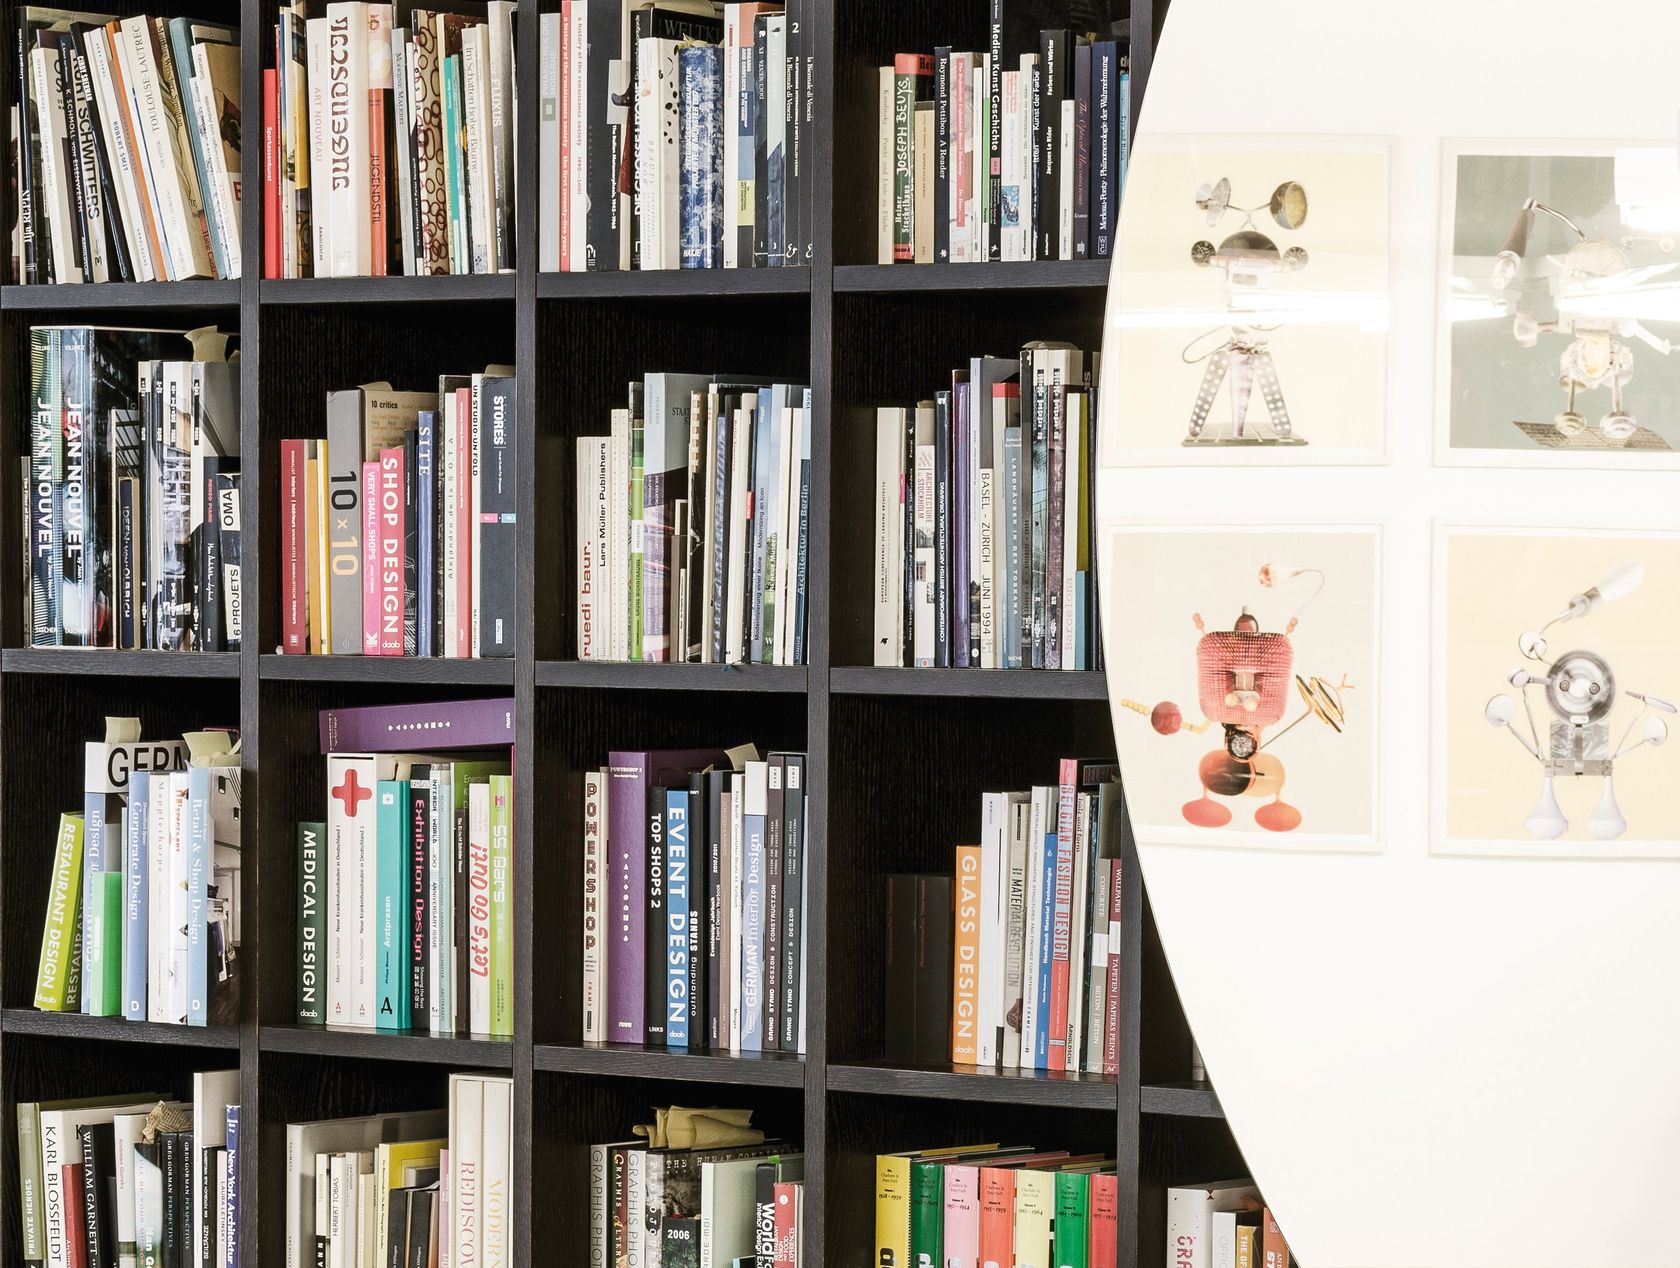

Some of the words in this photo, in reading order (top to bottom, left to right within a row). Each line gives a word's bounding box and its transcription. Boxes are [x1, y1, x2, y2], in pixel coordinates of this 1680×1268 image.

[791, 22, 800, 34] 2
[991, 23, 1000, 61] Medien
[131, 25, 160, 133] TOULOUSE-LAUTREC
[313, 87, 322, 106] ART
[938, 57, 948, 98] Raymond
[991, 63, 1000, 93] Kunst
[491, 79, 503, 128] FLUXUS
[938, 100, 948, 135] Pettibon
[991, 95, 1000, 151] Geschichte
[113, 121, 124, 149] ROBERT
[120, 151, 129, 173] SMIT
[265, 126, 273, 182] Sparkassenkunst
[314, 111, 323, 162] NOUVEAU
[895, 125, 910, 178] JOSEPH
[939, 139, 947, 147] A
[78, 107, 101, 221] SCHWITTERS
[369, 153, 381, 224] JUGENDSTIL
[939, 148, 947, 180] Reader
[37, 397, 52, 458] JEAN
[67, 397, 82, 458] JEAN
[378, 401, 398, 410] critics
[493, 395, 505, 445] STORES
[418, 425, 431, 477] SITE
[599, 442, 607, 501] Publishers
[330, 470, 358, 511] 10
[366, 470, 377, 496] VERY
[383, 457, 399, 526] SHOP
[799, 484, 808, 517] Berlin
[981, 472, 991, 510] BASEL
[37, 465, 52, 558] NOUVEL
[67, 465, 82, 558] NOUVEL
[223, 490, 235, 528] OMA
[366, 497, 377, 528] SMALL
[599, 503, 607, 539] Müller
[798, 519, 807, 530] in
[331, 535, 359, 576] 10
[366, 529, 377, 560] SHOPS
[581, 540, 592, 594] baur.
[599, 542, 607, 568] Lars
[796, 532, 807, 596] Architektur
[230, 568, 241, 625] PROJETS
[383, 538, 399, 633] DESIGN
[981, 574, 992, 600] JUNI
[233, 628, 242, 636] 6
[581, 603, 592, 657] ruedi
[982, 604, 993, 635] 1994
[128, 801, 141, 870] Corporate
[190, 799, 203, 838] Retail
[651, 812, 662, 844] TOP
[1059, 785, 1075, 841] BELGIAN
[190, 843, 202, 854] &
[413, 799, 426, 893] Exhibition
[470, 842, 489, 891] Out!
[651, 845, 662, 896] SHOPS
[669, 806, 686, 898] EVENT
[748, 833, 761, 884] Design
[52, 822, 76, 925] RESTAURANT
[128, 874, 141, 920] Design
[189, 859, 203, 894] Shop
[302, 830, 316, 918] MEDICAL
[960, 854, 977, 934] GLASS
[1056, 848, 1072, 904] FASHION
[189, 898, 202, 945] Design
[383, 895, 393, 948] Arztpraxen
[471, 894, 489, 922] Go
[651, 898, 661, 909] 2
[748, 887, 760, 941] Interior
[412, 898, 425, 961] Design
[470, 926, 489, 978] Let's
[689, 910, 699, 951] STANDS
[1054, 911, 1069, 960] DESIGN
[41, 928, 61, 988] DESIGN
[302, 926, 316, 1003] DESIGN
[669, 912, 686, 1022] DESIGN
[745, 944, 758, 1008] GERMAN
[1110, 957, 1119, 993] TAPETEN
[689, 956, 698, 1016] outstanding
[957, 945, 975, 1038] DESIGN
[1109, 1000, 1117, 1031] PAPIERS
[1108, 1033, 1116, 1060] PEINTS
[45, 1125, 58, 1168] KARL
[82, 1130, 94, 1189] WILLIAM
[227, 1149, 236, 1174] New
[24, 1178, 34, 1215] HEROES
[227, 1175, 236, 1201] York
[591, 1149, 603, 1224] GRAPHIS
[628, 1152, 639, 1226] GRAPHIS
[26, 1216, 36, 1255] PRIVATE
[46, 1173, 62, 1262] BLOSSFELDT
[86, 1192, 98, 1255] GARNETT
[145, 1225, 155, 1251] Nan
[226, 1202, 236, 1264] Architektur
[667, 1228, 690, 1240] 2006
[761, 1202, 775, 1255] World
[1239, 1235, 1248, 1253] THE
